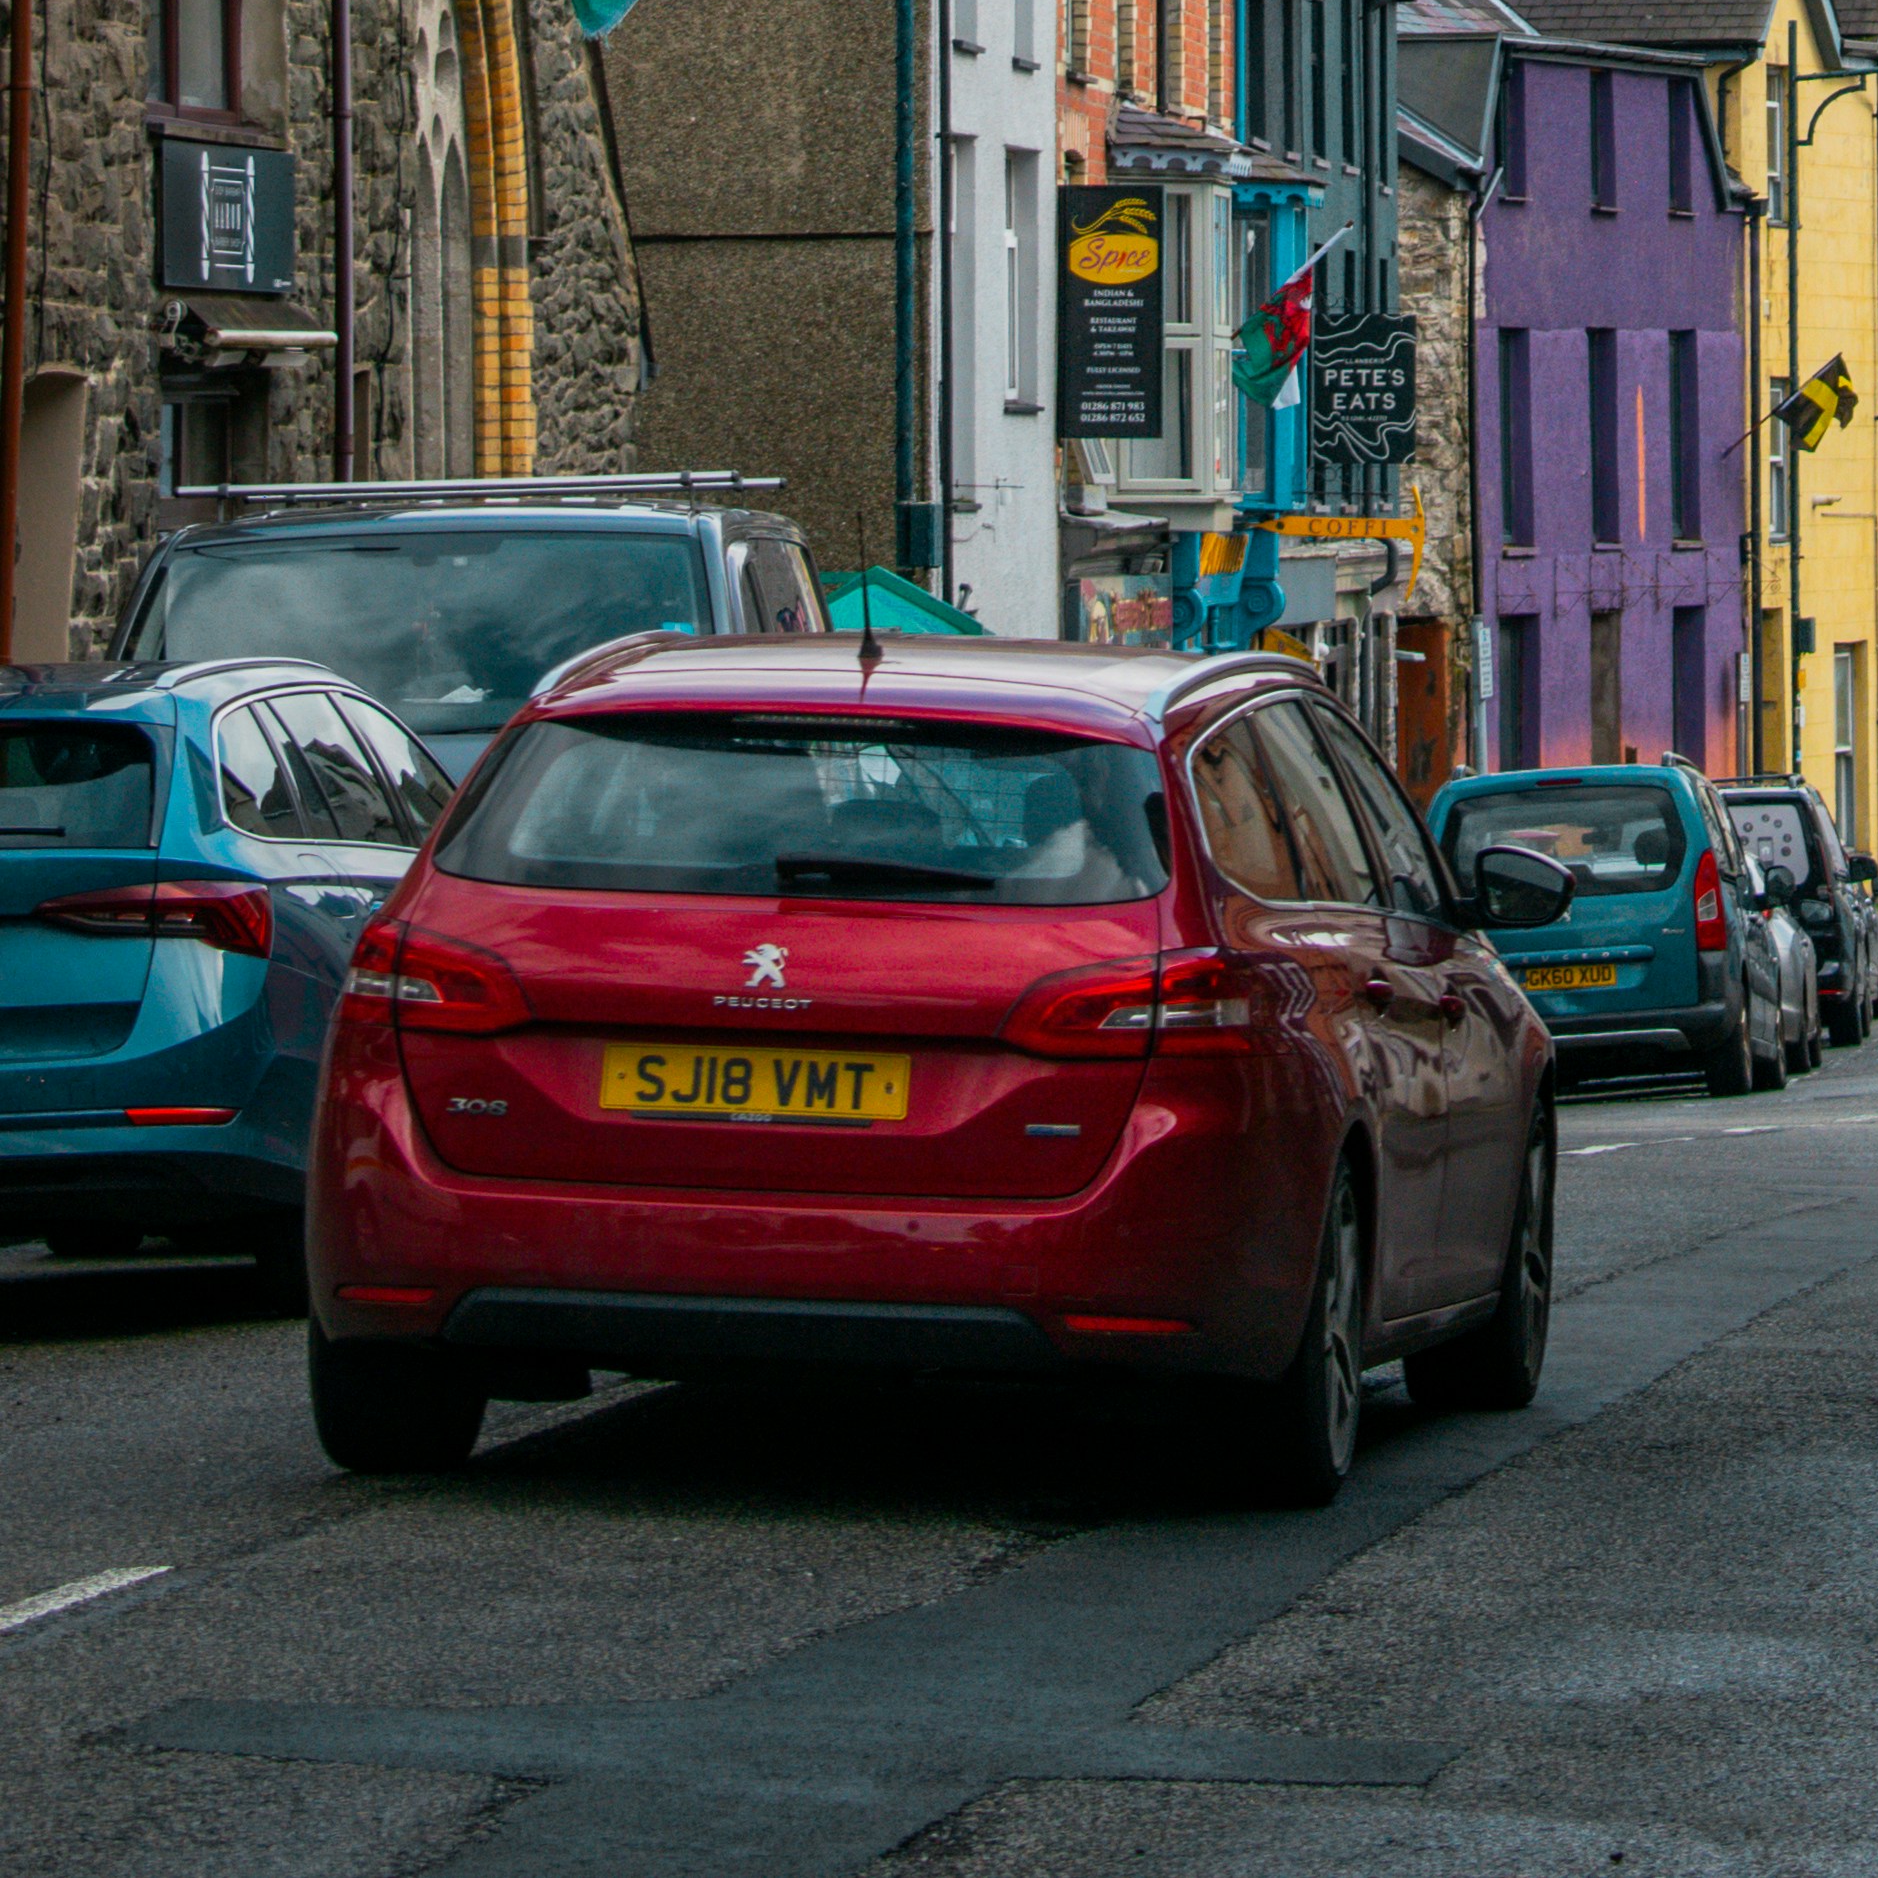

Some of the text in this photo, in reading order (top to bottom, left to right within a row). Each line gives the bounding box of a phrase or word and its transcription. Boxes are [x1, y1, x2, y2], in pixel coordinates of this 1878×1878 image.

[1079, 237, 1152, 274] Spice
[1094, 289, 1134, 297] INDIAN &
[1084, 299, 1144, 307] BANGLADESHI
[1086, 366, 1141, 374] FULLY LICENSED
[1324, 369, 1405, 386] PETE'S
[1081, 402, 1144, 410] 01286 871 983
[1333, 393, 1396, 410] EATS
[1081, 414, 1145, 422] 01286 872 652
[1309, 519, 1387, 535] COFFI
[1503, 950, 1629, 964] EUGEOT
[1528, 964, 1613, 987] GK60 XUD
[713, 995, 813, 1010] PEUGEOT
[635, 1054, 875, 1111] SJ18 VMT
[446, 1096, 509, 1116] 308
